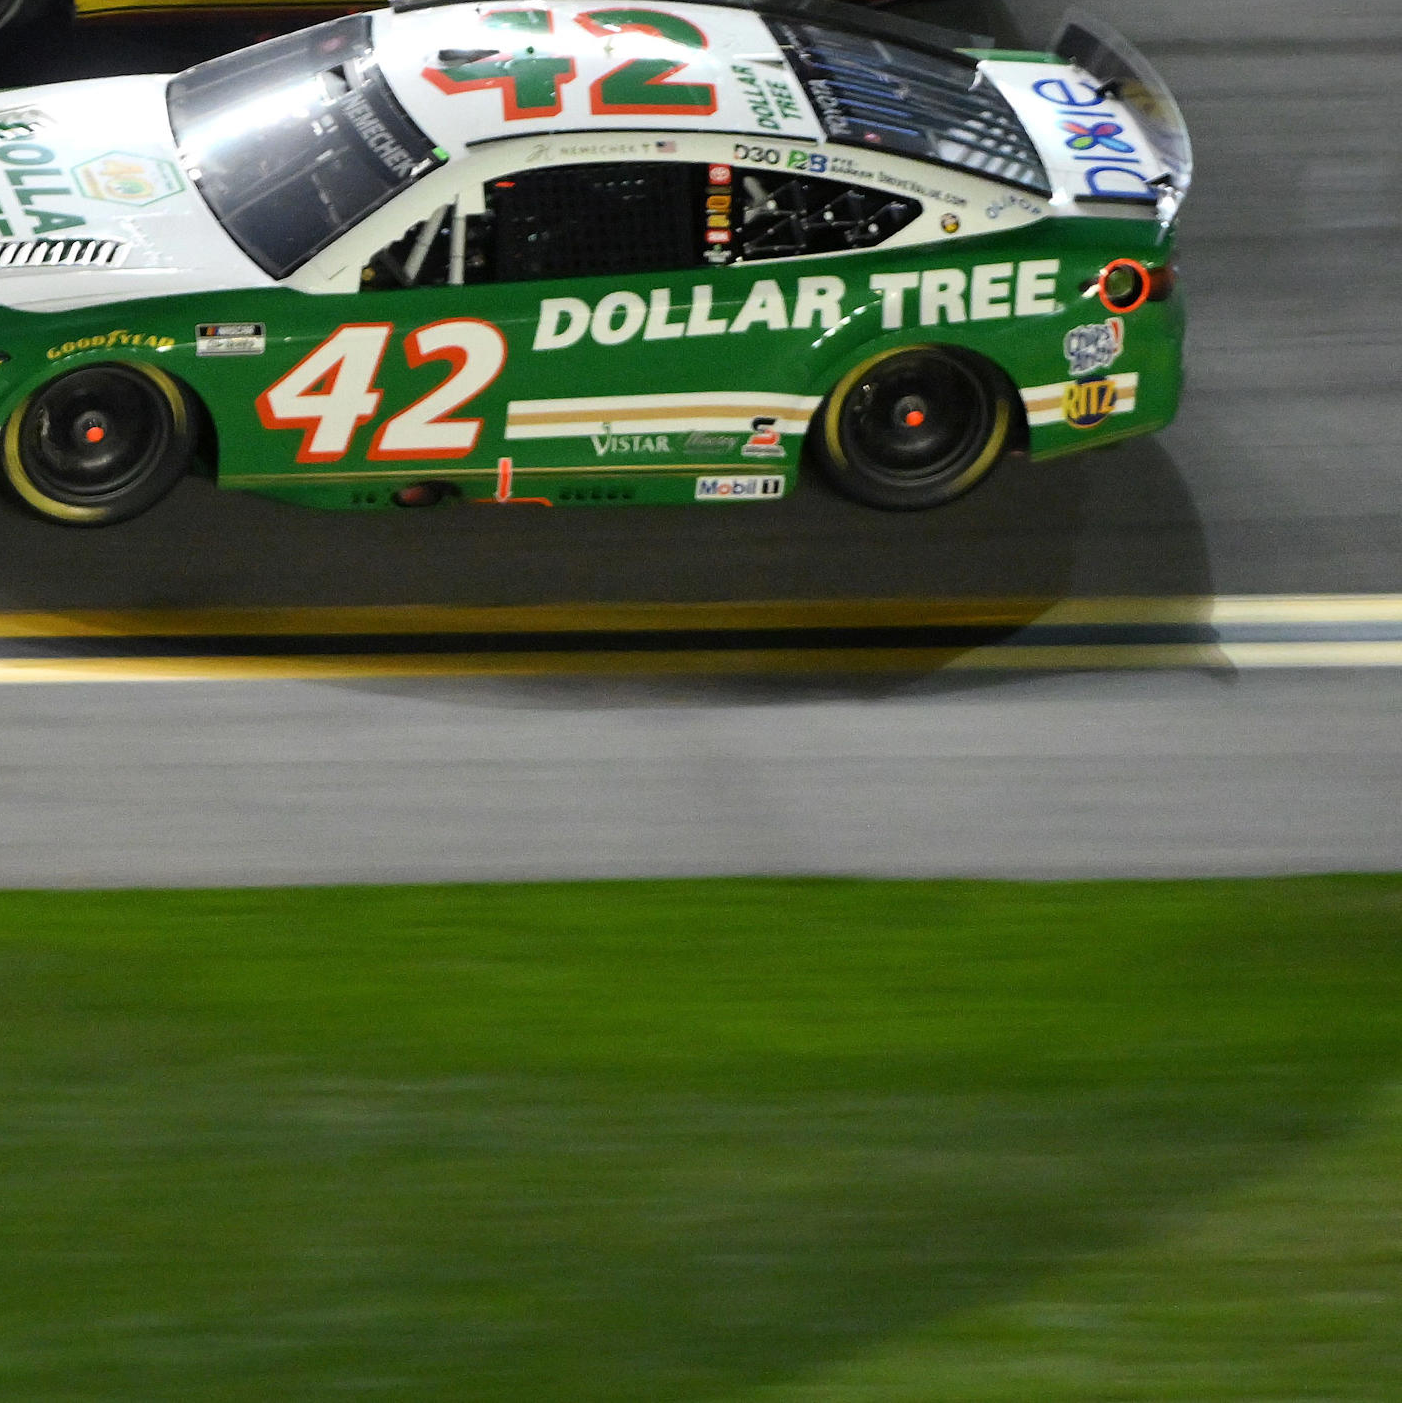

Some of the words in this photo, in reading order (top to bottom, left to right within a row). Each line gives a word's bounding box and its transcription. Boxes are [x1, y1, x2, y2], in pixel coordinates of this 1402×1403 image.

[422, 7, 717, 122] 42
[732, 65, 779, 131] DOLLAR
[764, 81, 801, 122] TREE
[341, 95, 412, 178] NEMECHEK
[532, 274, 848, 351] DOLLAR
[869, 259, 1061, 329] TREE
[256, 316, 507, 463] 42
[1062, 380, 1117, 419] RITZ
[590, 423, 670, 456] VISTAR
[699, 479, 756, 496] Mobil
